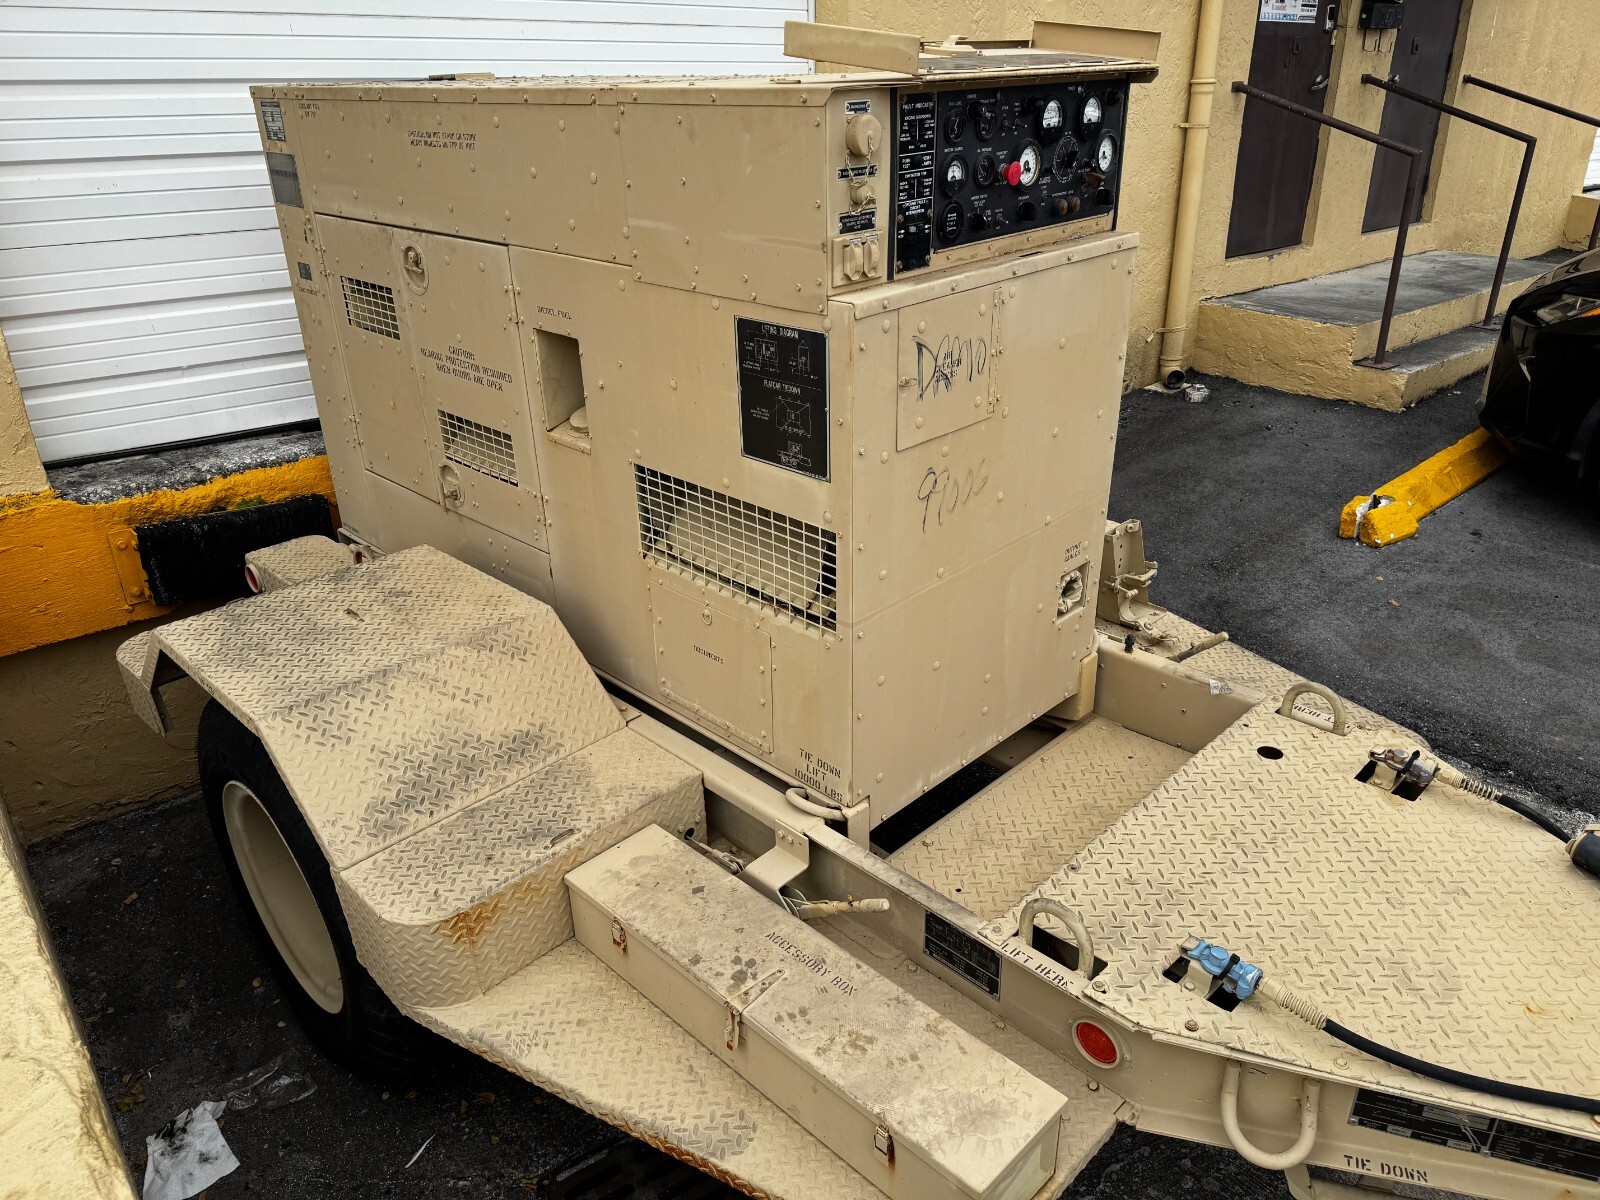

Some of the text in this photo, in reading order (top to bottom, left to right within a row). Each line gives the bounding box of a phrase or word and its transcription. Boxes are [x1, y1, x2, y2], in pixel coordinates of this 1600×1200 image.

[761, 324, 799, 339] LIFTING DIAGRAM
[444, 354, 481, 374] PROTECTION
[481, 365, 513, 384] REQUIRED
[452, 368, 472, 381] DOORS
[473, 374, 485, 386] ARE
[486, 378, 503, 392] OPEN
[799, 747, 841, 779] TIE DOWN
[806, 763, 827, 782] LIFT
[794, 768, 843, 803] 10000 LBS
[764, 931, 858, 996] ACCESSORY BOX
[1001, 943, 1074, 989] LIFT HERE
[1343, 1154, 1428, 1183] TIE DOWN
